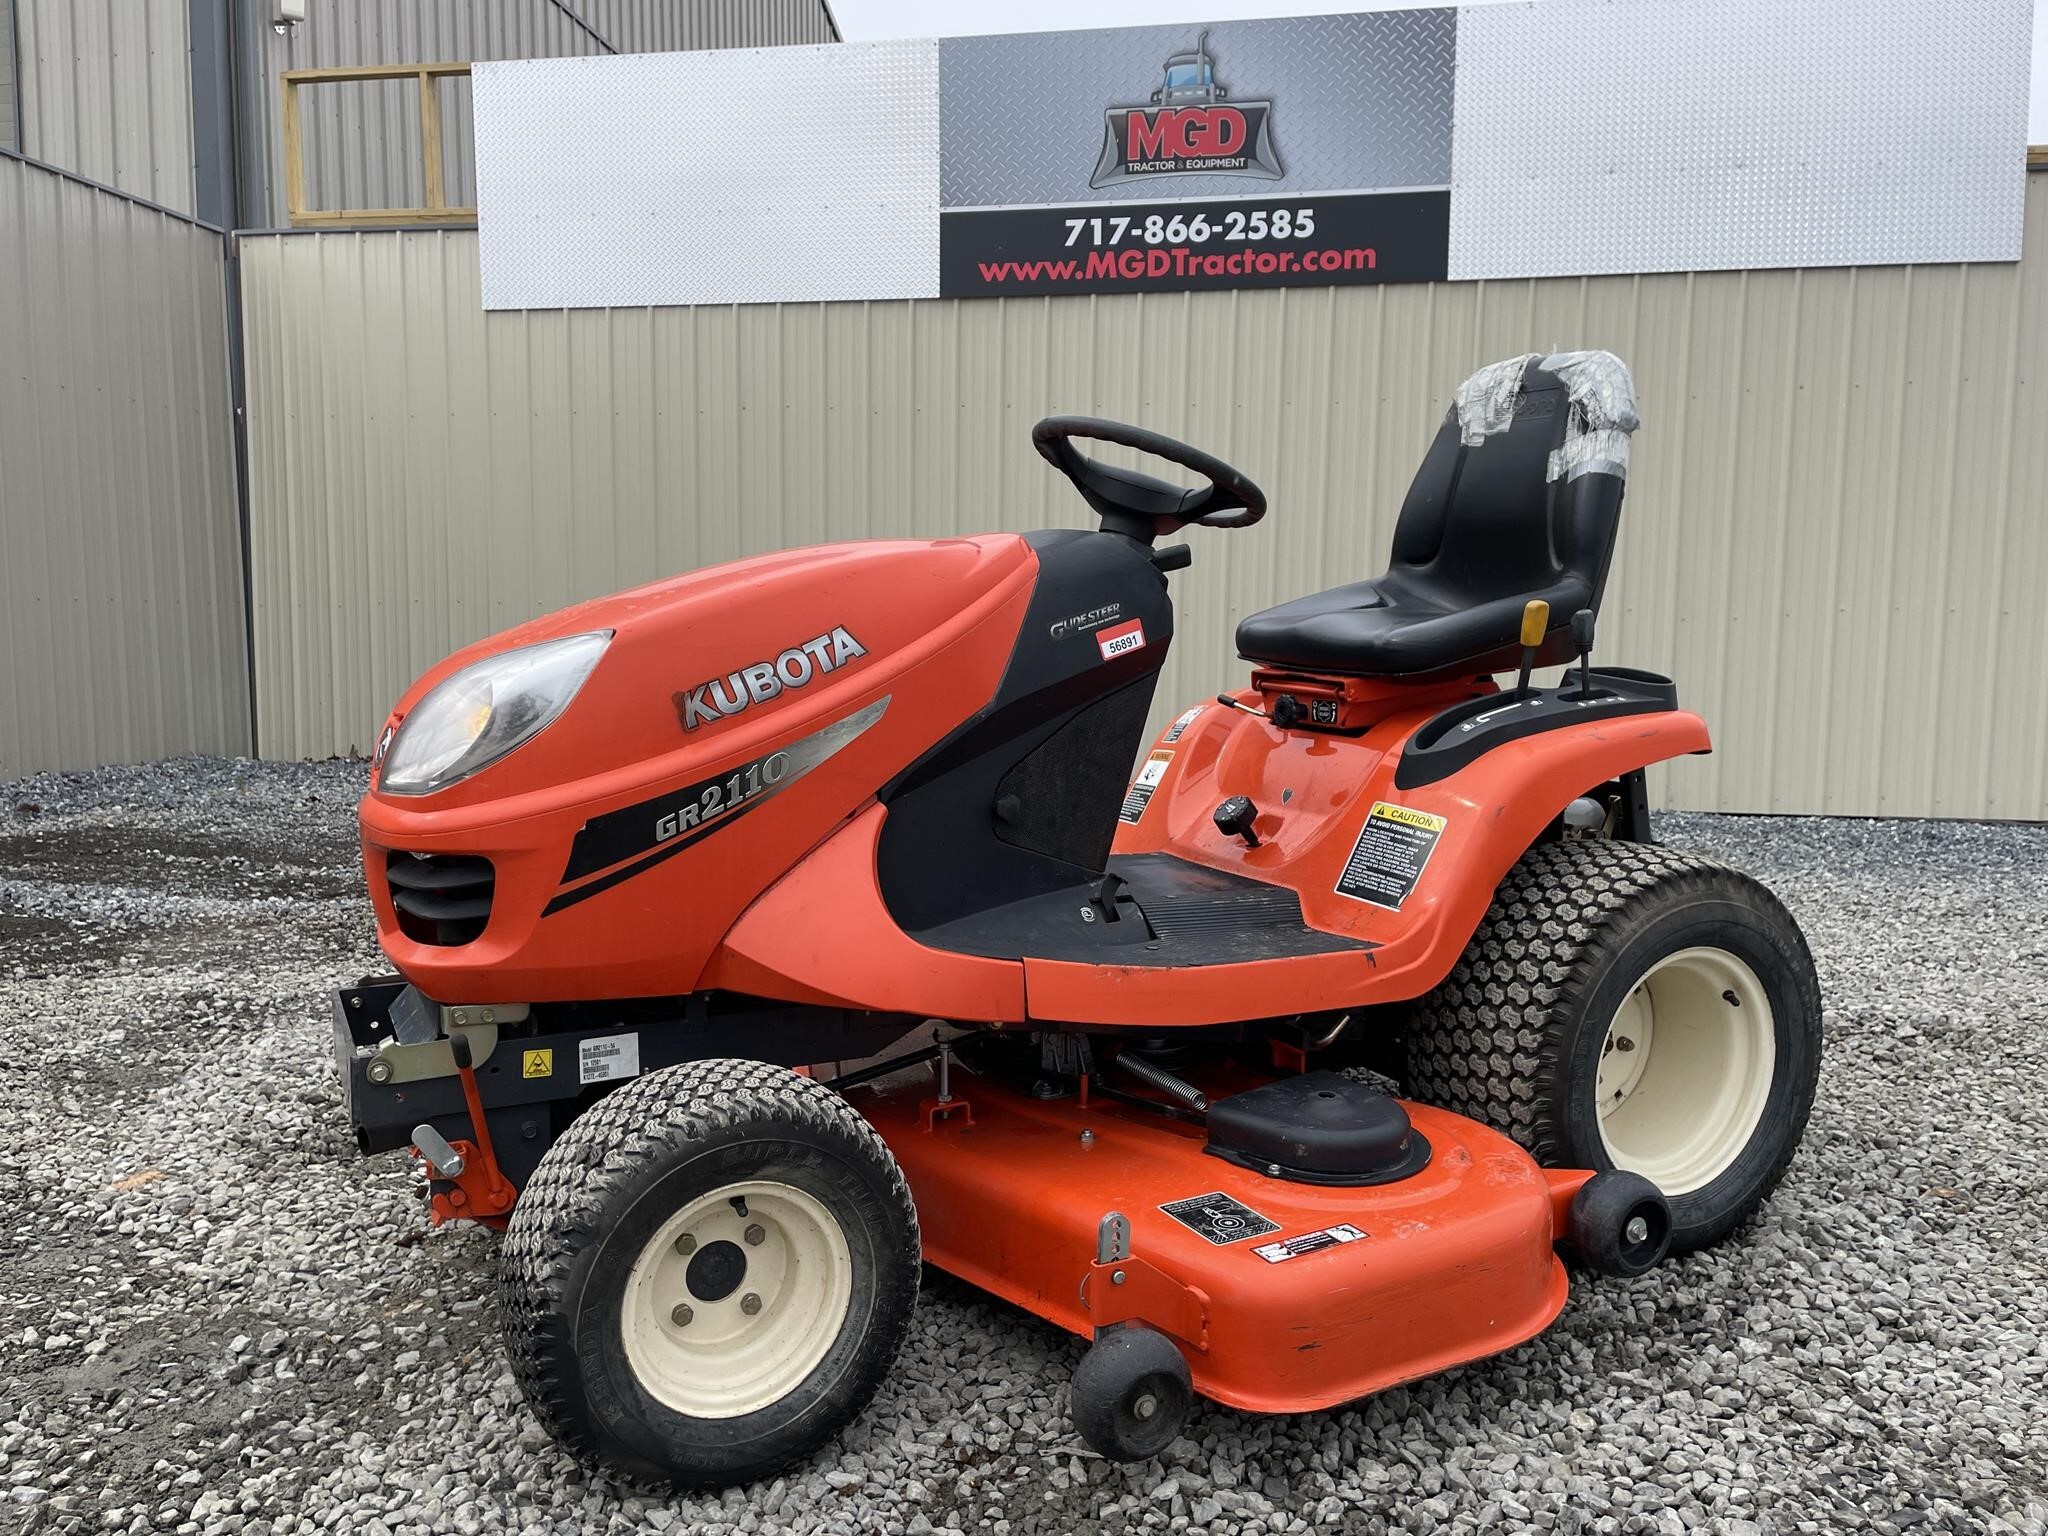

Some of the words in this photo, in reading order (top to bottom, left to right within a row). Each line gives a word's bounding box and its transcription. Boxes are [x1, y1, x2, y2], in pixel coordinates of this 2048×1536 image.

[1127, 106, 1246, 160] MGD
[1127, 160, 1176, 172] TRACTOR
[1186, 157, 1246, 169] EQUIPMENT
[1064, 209, 1315, 246] 717-866-2585
[978, 247, 1377, 282] www.MGDTractor.com
[1109, 635, 1138, 654] 56891
[682, 625, 868, 731] KUBOTA
[655, 751, 791, 842] GR2110
[1390, 823, 1415, 835] PERSONAL
[1415, 830, 1434, 840] INJURY
[1391, 810, 1433, 827] CAUTION
